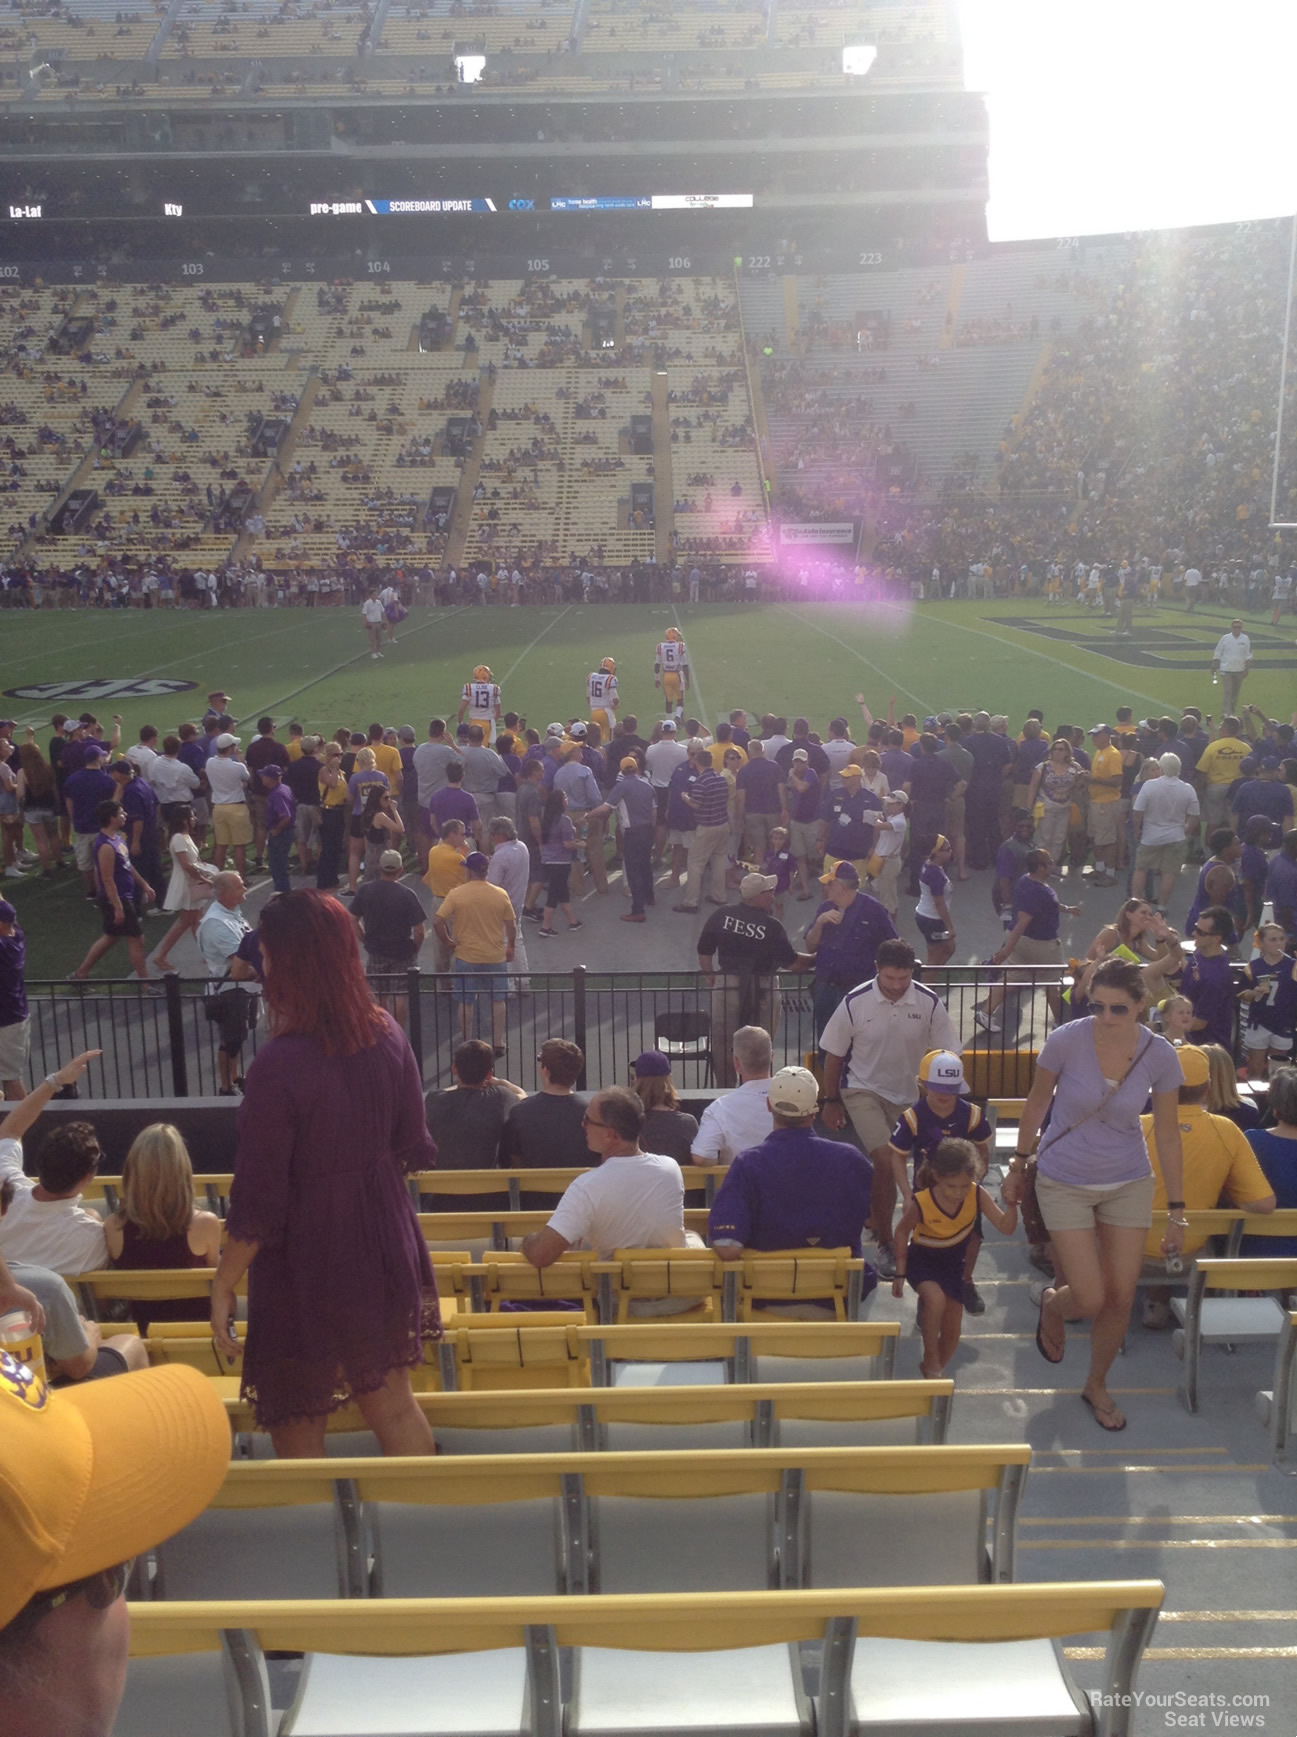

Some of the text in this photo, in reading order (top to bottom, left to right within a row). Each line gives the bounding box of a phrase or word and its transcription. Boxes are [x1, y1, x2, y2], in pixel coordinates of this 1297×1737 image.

[164, 203, 183, 217] Kty
[310, 202, 362, 215] pre-game
[389, 200, 472, 212] SCOREBOARD UPDATE
[668, 257, 691, 269] 106
[748, 256, 771, 268] 222
[859, 252, 882, 265] 223
[182, 263, 204, 275] 103
[367, 261, 391, 273] 104
[527, 259, 550, 271] 105
[665, 648, 674, 662] 6
[591, 680, 602, 698] 16
[475, 690, 489, 708] 13
[722, 915, 767, 940] FESS
[1266, 980, 1279, 1007] 7
[907, 1012, 922, 1020] LSU
[937, 1067, 960, 1078] LSU
